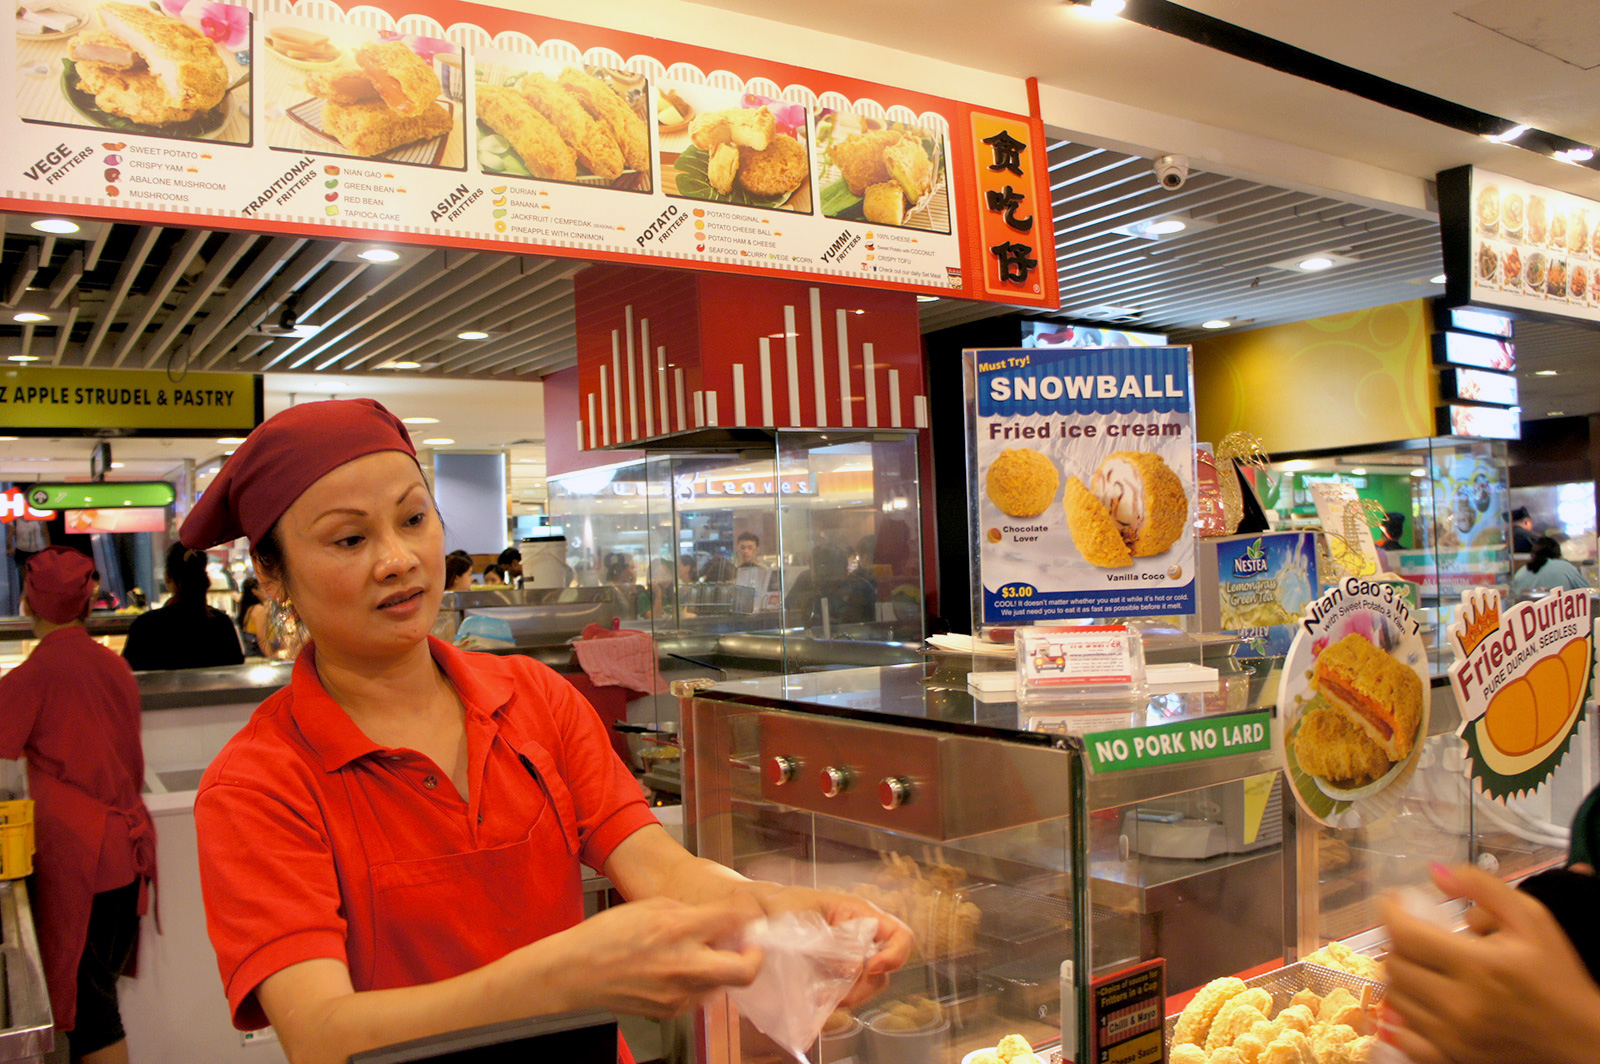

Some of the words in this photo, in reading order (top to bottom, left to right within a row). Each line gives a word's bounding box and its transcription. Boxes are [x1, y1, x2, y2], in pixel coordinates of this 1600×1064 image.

[130, 146, 160, 156] SWEET
[164, 149, 198, 159] POTATO
[23, 143, 72, 181] VEGE
[46, 146, 94, 185] FRITTERS
[130, 161, 162, 170] CRISPY
[165, 164, 183, 172] YAM
[344, 169, 362, 177] NIAN
[365, 171, 381, 179] GAO
[130, 176, 172, 186] ABALONE
[174, 180, 225, 191] MUSHROOM
[242, 156, 315, 217] TRADITIONAL
[276, 170, 317, 206] FRITTERS
[344, 182, 371, 192] GREEN
[374, 185, 394, 193] BEAN
[130, 190, 188, 201] MUSHROOMS
[510, 187, 537, 196] DURIAN
[344, 196, 360, 204] RED
[363, 197, 383, 206] BEAN
[430, 184, 470, 223] ASIAN
[448, 188, 484, 222] FRITTERS
[510, 200, 539, 209] BANANA
[344, 210, 378, 219] TAPIOCA
[380, 213, 399, 221] CAKE
[511, 213, 548, 223] JACKFRUIT
[554, 218, 592, 227] CEMPEDAK
[707, 211, 730, 219] POTATO
[732, 214, 759, 223] ORIGINAL
[511, 226, 549, 236] PINEAPPLE
[551, 230, 569, 238] WITH
[636, 205, 678, 248] POTATO
[658, 212, 688, 244] FRITTERS
[708, 223, 731, 231] POTATO
[733, 226, 756, 234] CHEESE
[708, 235, 732, 243] POTATO
[753, 239, 776, 248] CHEESE
[820, 229, 852, 264] YUMMI
[836, 234, 861, 264] FRITTERS
[709, 247, 738, 255] SEAFOOD
[979, 360, 1006, 373] Must
[1008, 355, 1030, 369] Try!
[990, 374, 1184, 401] SNOWBALL
[13, 387, 69, 404] APPLE
[75, 388, 151, 405] STRUDEL
[157, 390, 168, 406] &
[174, 390, 235, 406] PASTRY
[989, 422, 1050, 439] Fried
[1060, 422, 1097, 438] ice
[1106, 423, 1182, 437] cream
[706, 479, 807, 495] Leaves
[1003, 525, 1048, 533] Chocolate
[1234, 559, 1268, 572] NESTEA
[1107, 573, 1139, 582] Vanilla
[1141, 573, 1165, 581] Coco
[1002, 586, 1033, 599] $3.00
[1226, 580, 1276, 596] Lemongrass
[1231, 594, 1257, 607] Green
[1259, 593, 1274, 602] Tea
[1304, 589, 1343, 635] Nian
[1346, 578, 1380, 597] Gao
[1384, 585, 1394, 604] 3
[1396, 596, 1409, 621] in
[1412, 620, 1420, 635] 1
[1113, 604, 1139, 612] possible
[1323, 612, 1339, 632] with
[1339, 601, 1361, 617] Sweet
[1363, 600, 1385, 615] Potato
[1386, 609, 1391, 617] &
[1393, 614, 1406, 635] Yam
[1457, 619, 1517, 702] Fried
[1520, 590, 1587, 642] Durian
[1483, 671, 1506, 700] PURE
[1539, 623, 1577, 649] SEEDLESS
[1095, 739, 1129, 763] NO
[1133, 732, 1186, 758] PORK
[1189, 729, 1217, 751] NO
[1222, 723, 1264, 747] LARD
[1130, 1016, 1136, 1025] &
[1138, 1010, 1156, 1021] Mayo
[1101, 1051, 1107, 1060] 2
